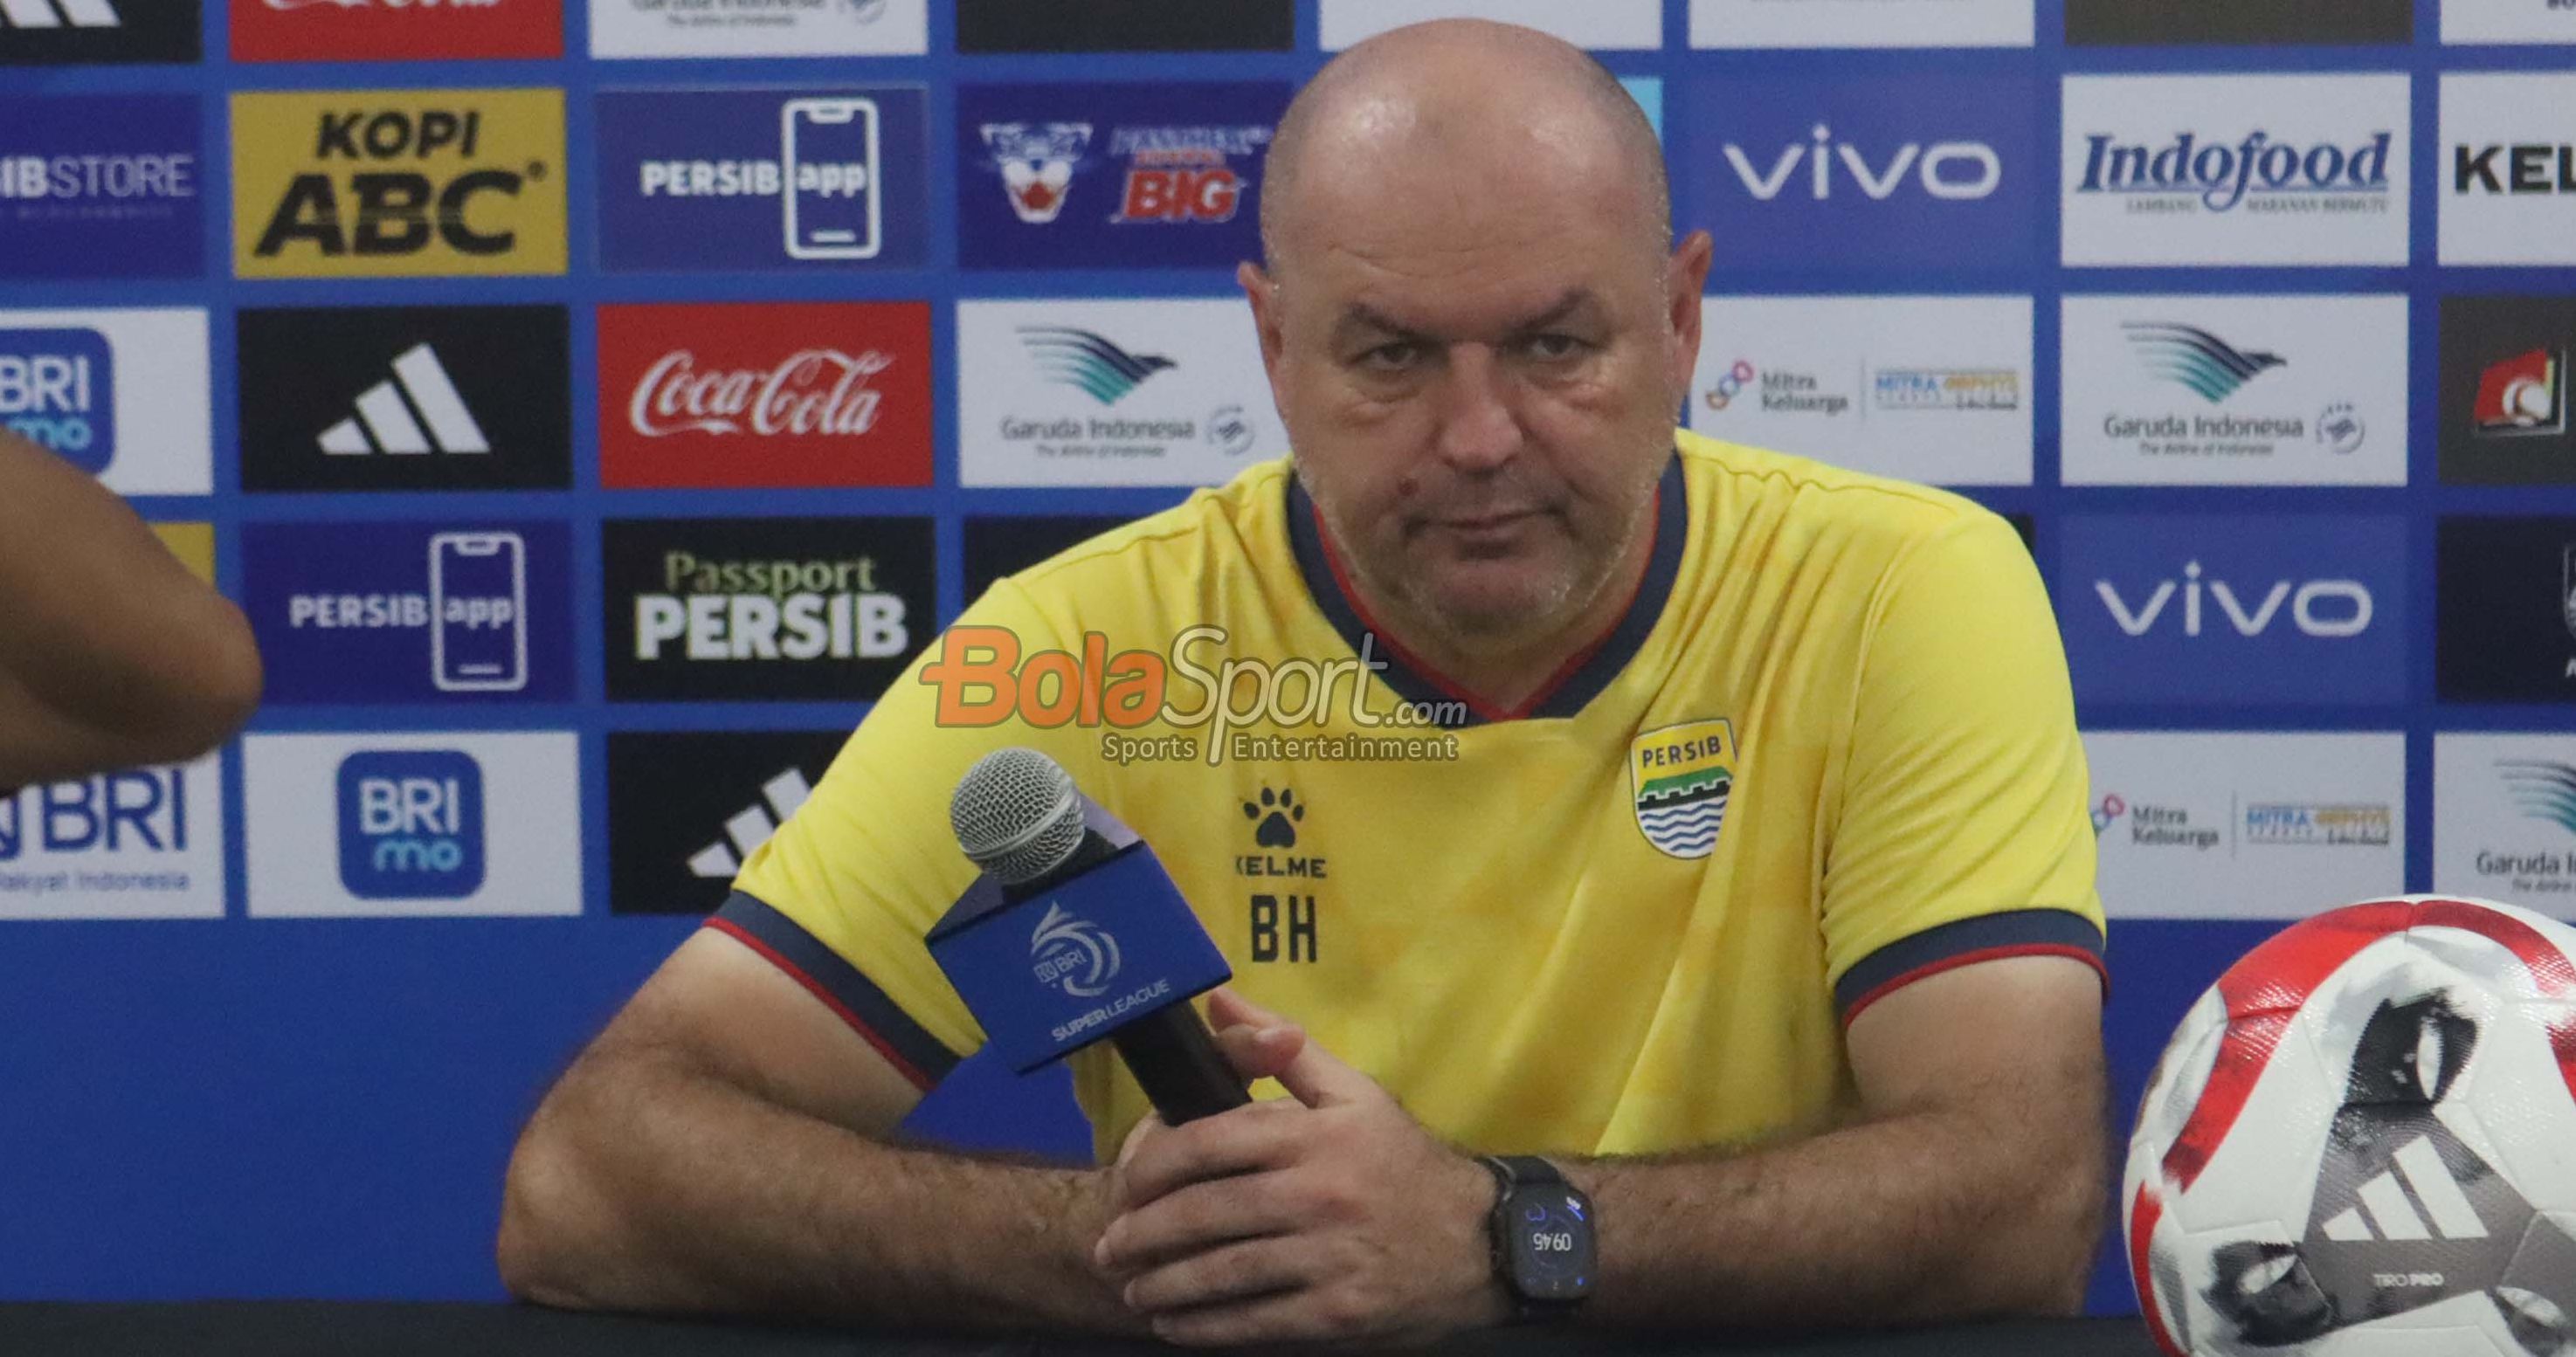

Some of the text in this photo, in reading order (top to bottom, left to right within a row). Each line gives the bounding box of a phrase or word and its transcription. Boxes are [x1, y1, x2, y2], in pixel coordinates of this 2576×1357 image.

[316, 111, 480, 159] KOPI
[641, 160, 867, 198] PERSIB app
[1723, 124, 2001, 199] vivo
[2076, 131, 2392, 211] Indofood
[1122, 169, 1240, 221] BIG
[253, 170, 522, 257] ABC
[1762, 371, 1817, 390] Mitra
[1762, 394, 1848, 415] Keluarga
[1001, 416, 1196, 439] Garuda Indonesia
[2103, 414, 2304, 438] Garuda Indonesia
[664, 550, 876, 598] Passport
[290, 596, 514, 627] PERSIB app
[2096, 561, 2373, 637] vivo
[635, 595, 908, 659] PERSIB
[1642, 735, 1721, 768] PERSIB
[43, 768, 187, 851] BRI
[359, 778, 459, 835] BRI
[2132, 806, 2187, 824] Mitra
[374, 840, 461, 872] mo
[2132, 828, 2219, 850] Keluarga
[2476, 849, 2560, 874] Garuda
[79, 873, 190, 892] Indonesia
[1251, 894, 1316, 962] BH
[1054, 947, 1088, 973] BRI
[1052, 979, 1170, 1041] SUPER LEAGUE
[2374, 1272, 2445, 1287] TIRO PRO
